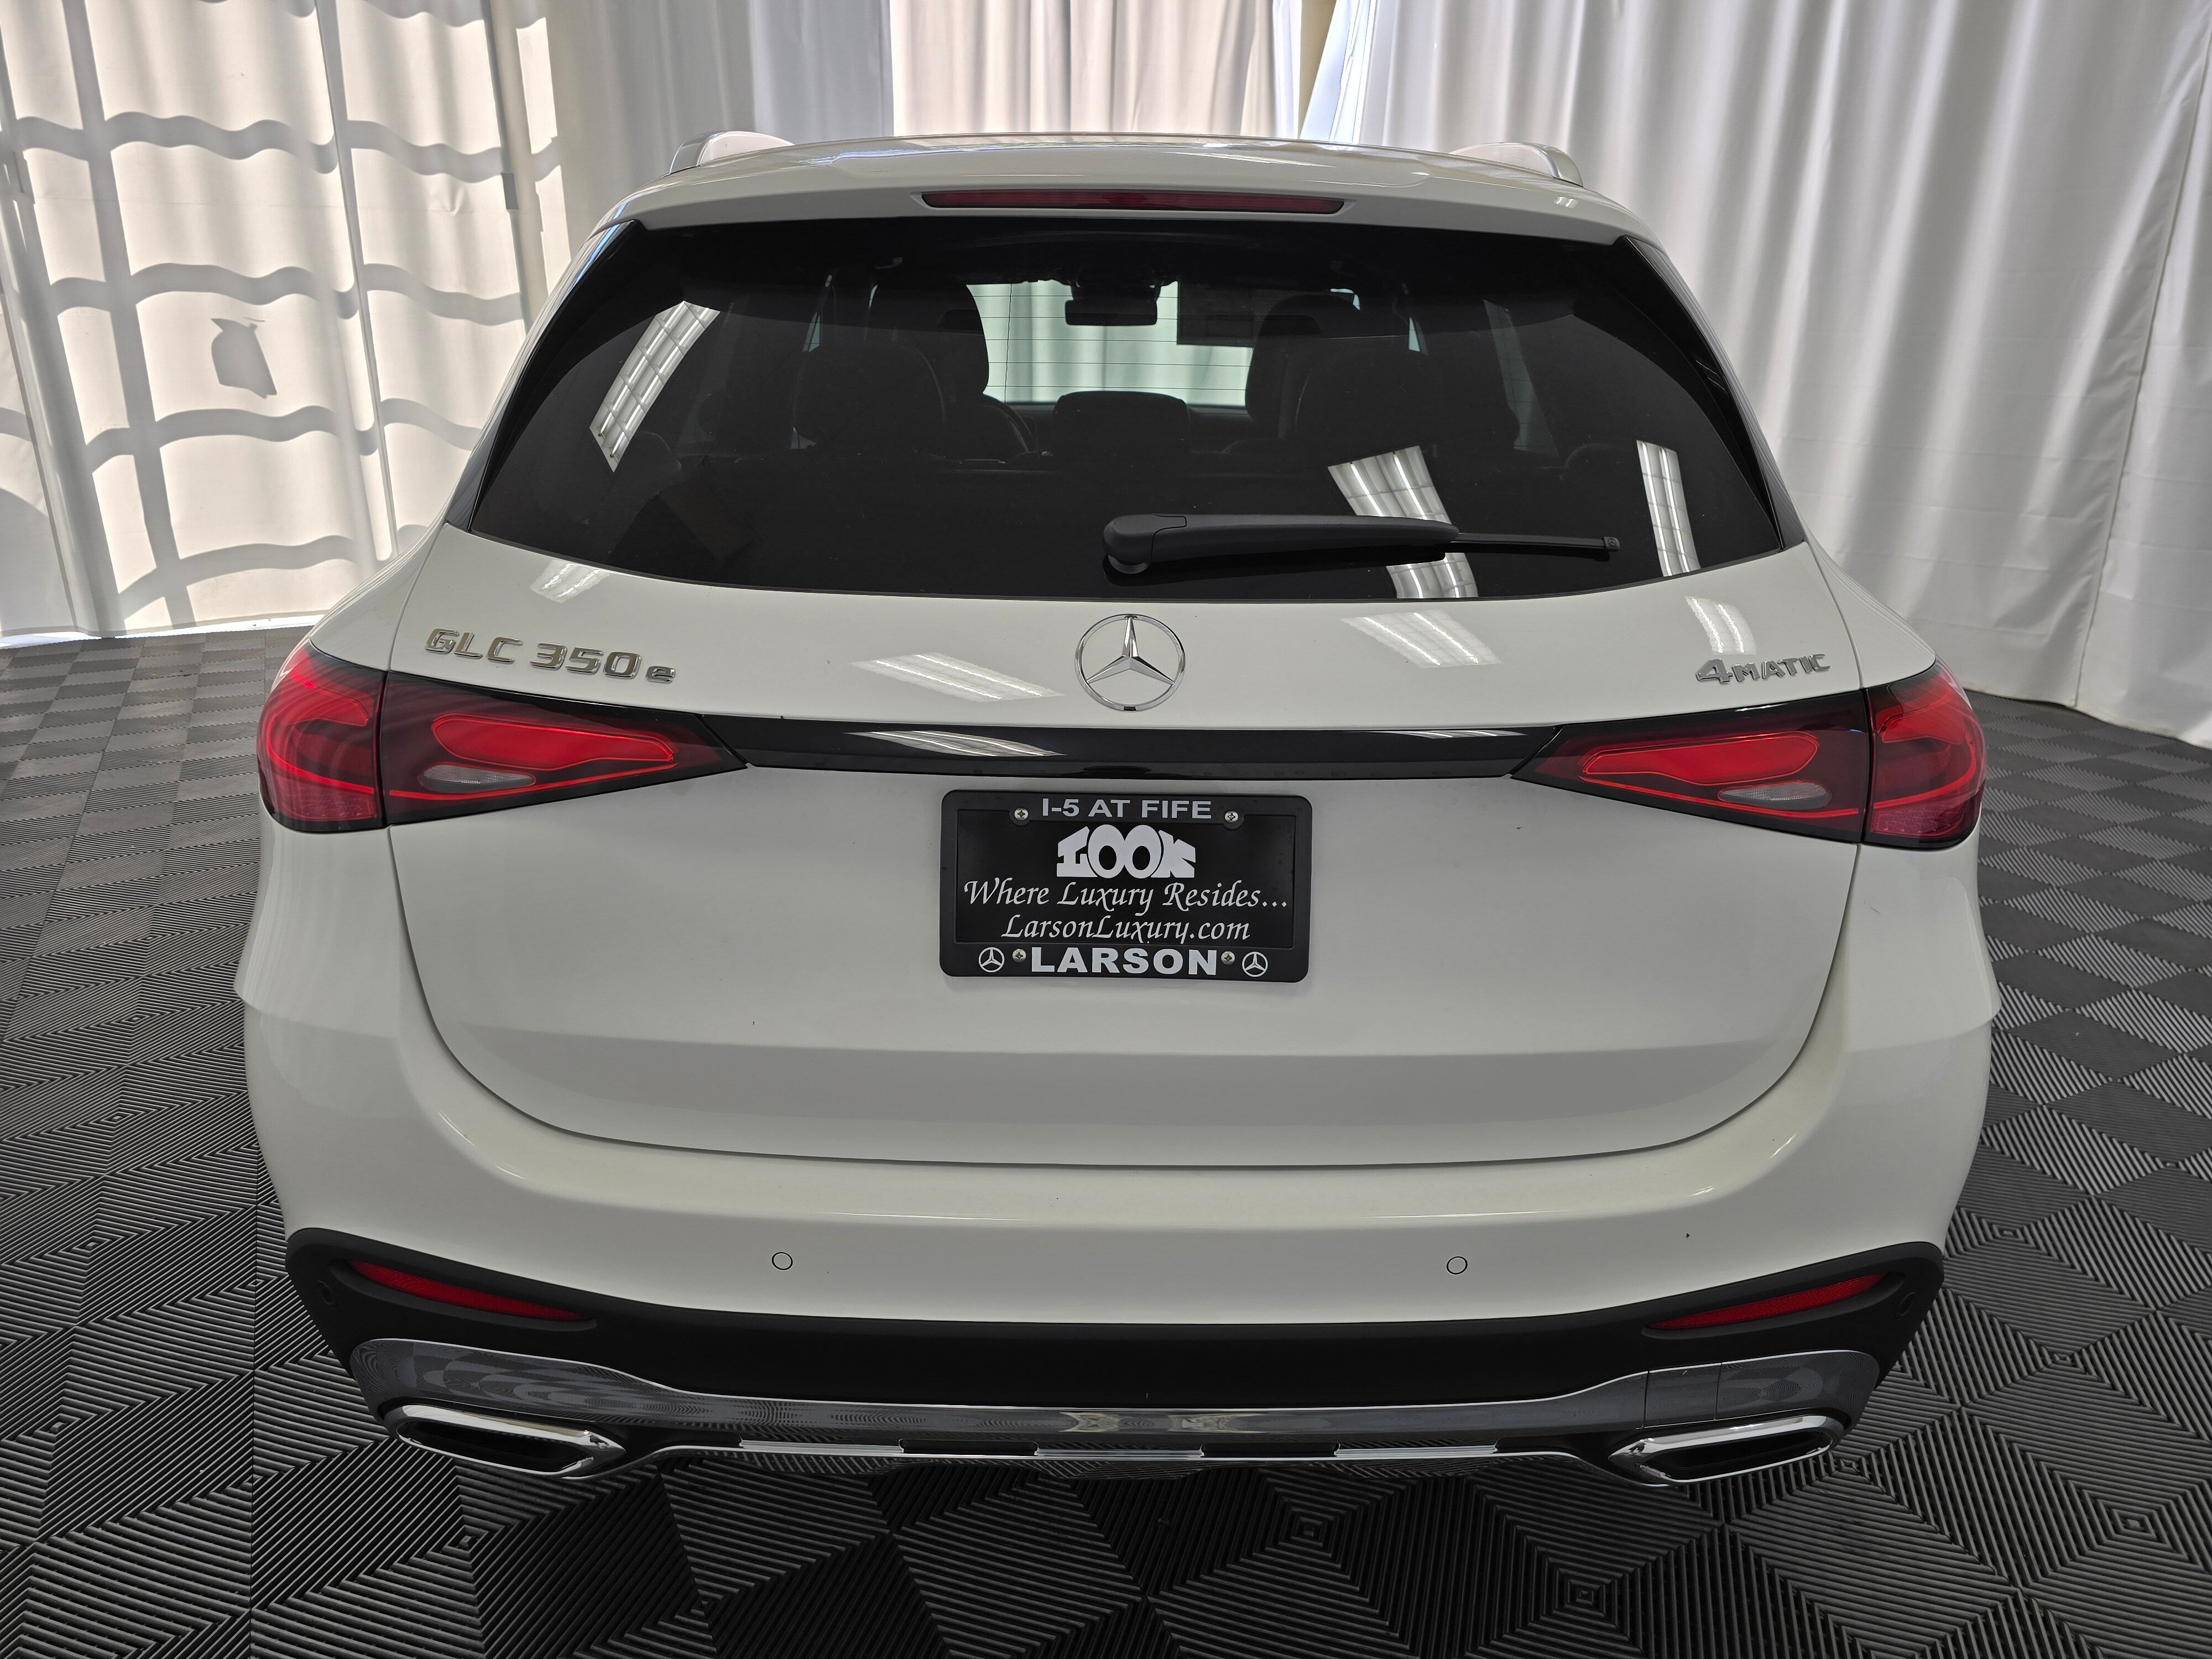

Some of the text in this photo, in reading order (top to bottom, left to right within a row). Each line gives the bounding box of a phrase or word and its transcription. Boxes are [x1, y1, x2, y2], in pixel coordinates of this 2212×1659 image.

[425, 627, 523, 664] GLC
[1695, 654, 1830, 684] 4MATIC
[1042, 798, 1212, 819] I-5 AT FIFE
[1056, 824, 1196, 879] LOOK
[964, 877, 1287, 916] Where Luxury Resides...
[1000, 914, 1251, 945] LarsonLuxury.com
[1031, 947, 1218, 975] LARSON
